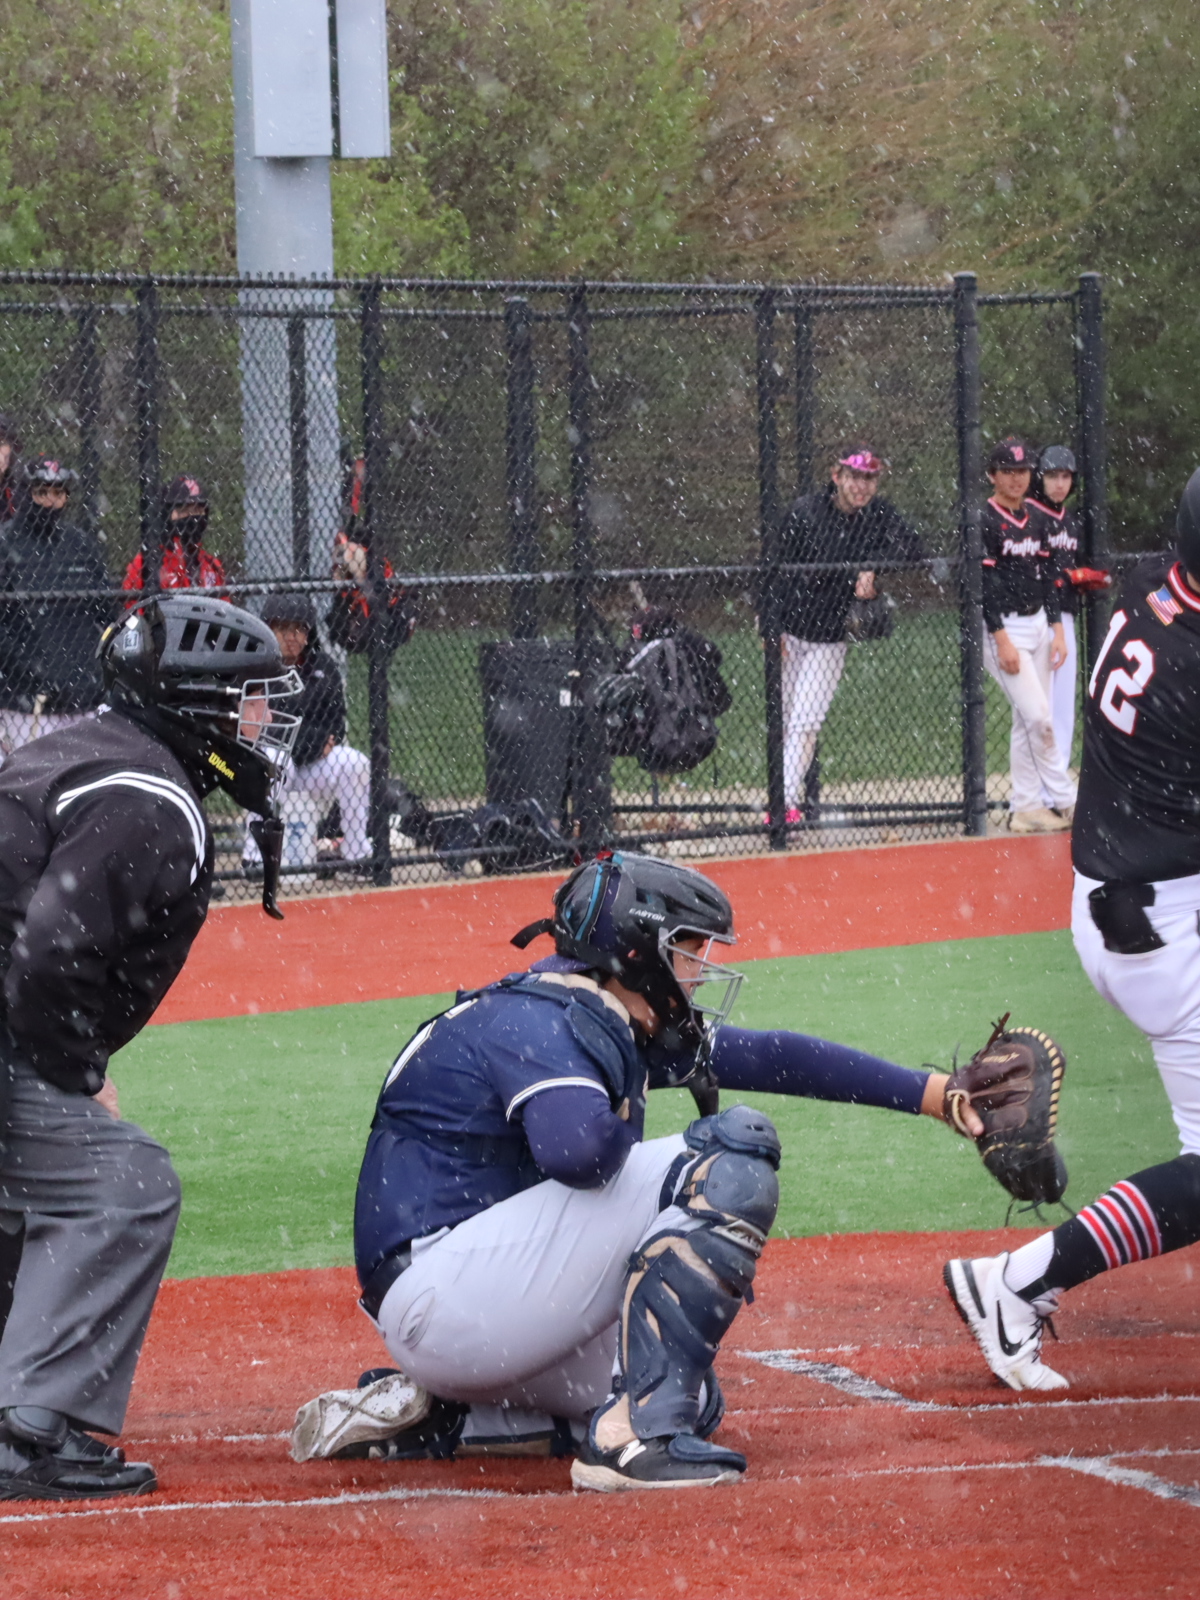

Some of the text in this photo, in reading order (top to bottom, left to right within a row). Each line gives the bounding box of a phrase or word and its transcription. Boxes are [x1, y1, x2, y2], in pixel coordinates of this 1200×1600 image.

[1088, 608, 1156, 736] 12
[208, 752, 234, 780] Wilson
[629, 908, 666, 922] EASTON
